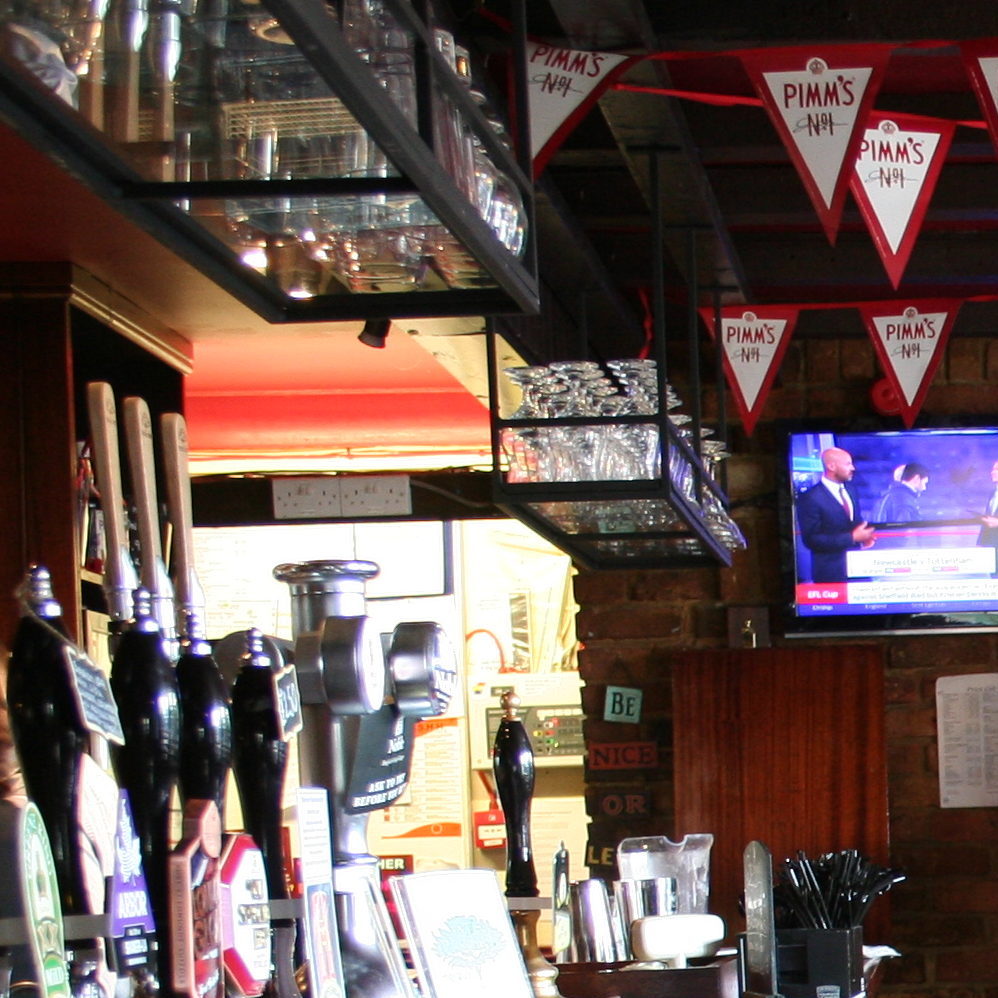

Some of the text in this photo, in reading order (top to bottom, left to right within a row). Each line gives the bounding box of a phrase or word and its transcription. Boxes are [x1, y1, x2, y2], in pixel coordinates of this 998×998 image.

[530, 44, 606, 78] PIMM'S
[784, 76, 855, 108] PIMM'S
[858, 137, 925, 164] PIMM'S
[727, 323, 776, 345] PIMM'S
[886, 318, 936, 341] PIMM'S
[611, 692, 636, 717] BE
[593, 746, 656, 767] NICE
[352, 793, 387, 808] BEFORE
[602, 795, 646, 816] OR
